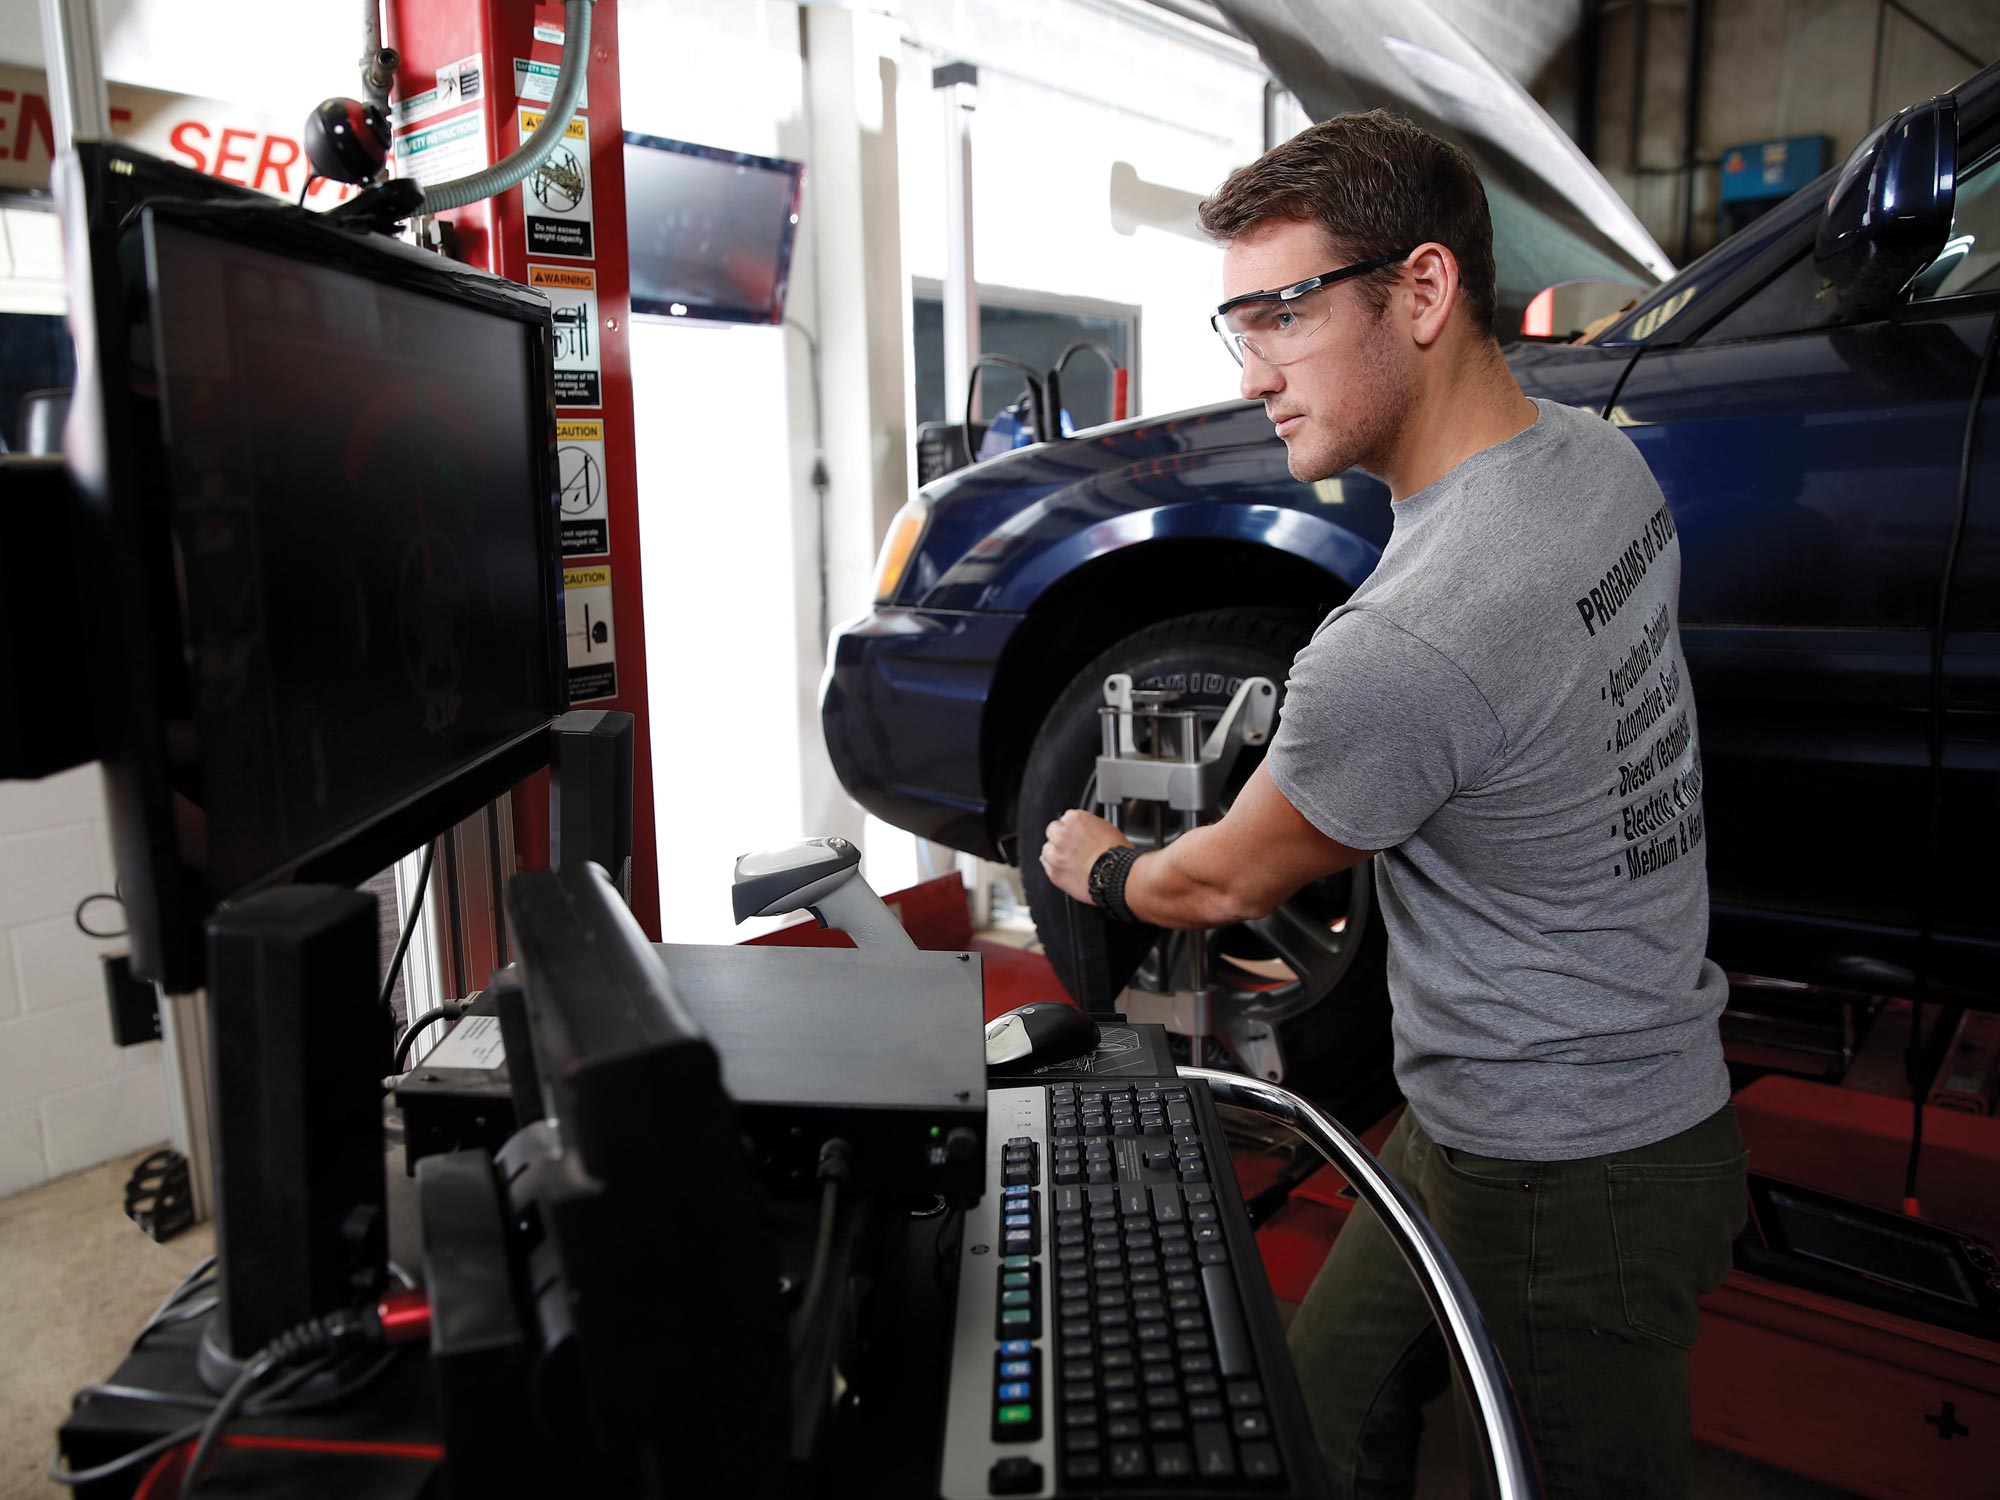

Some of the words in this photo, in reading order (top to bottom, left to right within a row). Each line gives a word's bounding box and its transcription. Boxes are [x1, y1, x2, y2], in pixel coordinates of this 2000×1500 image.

[168, 121, 362, 201] SER
[535, 222, 545, 232] Do
[544, 273, 591, 287] WARNING
[556, 426, 598, 437] CAUTION
[564, 571, 606, 585] CAUTION
[1576, 539, 1647, 638] PROGRAMS
[1642, 523, 1656, 564] of
[1609, 638, 1652, 708] Agriculture
[1616, 686, 1666, 754] Automotive
[1618, 745, 1656, 798] Diesel
[1621, 788, 1676, 842] Electric
[1673, 777, 1687, 811] &
[1625, 833, 1678, 881] Medium
[1679, 820, 1688, 856] &
